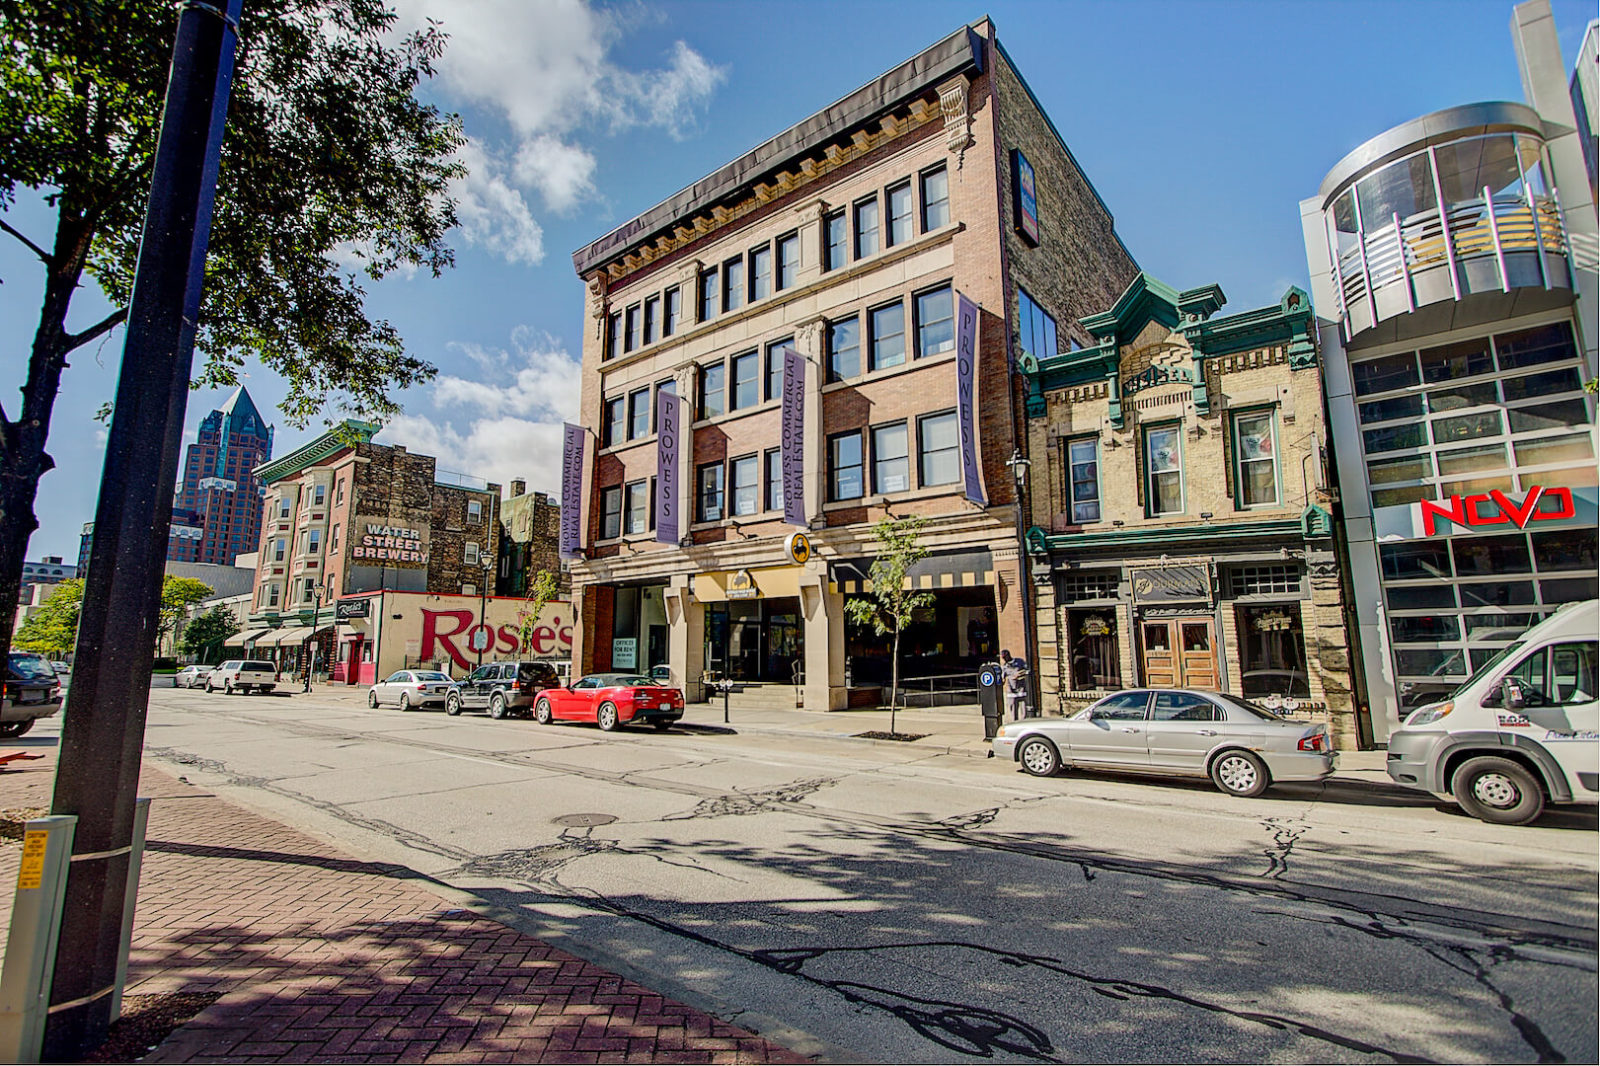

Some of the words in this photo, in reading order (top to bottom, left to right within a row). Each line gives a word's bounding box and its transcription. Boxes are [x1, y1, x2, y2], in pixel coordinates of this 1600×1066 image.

[782, 356, 796, 450] COMMERCIAL
[957, 313, 971, 467] PROWESS
[563, 430, 575, 501] COMMERCIAL
[660, 401, 675, 518] PROWESS
[783, 454, 795, 519] PROWESS
[793, 471, 804, 501] REAL
[1420, 485, 1576, 537] NOVO
[362, 535, 422, 551] STREET
[367, 523, 420, 540] WATER
[562, 503, 571, 554] PROWESS
[571, 513, 579, 540] REAL
[353, 546, 428, 563] BREWERY
